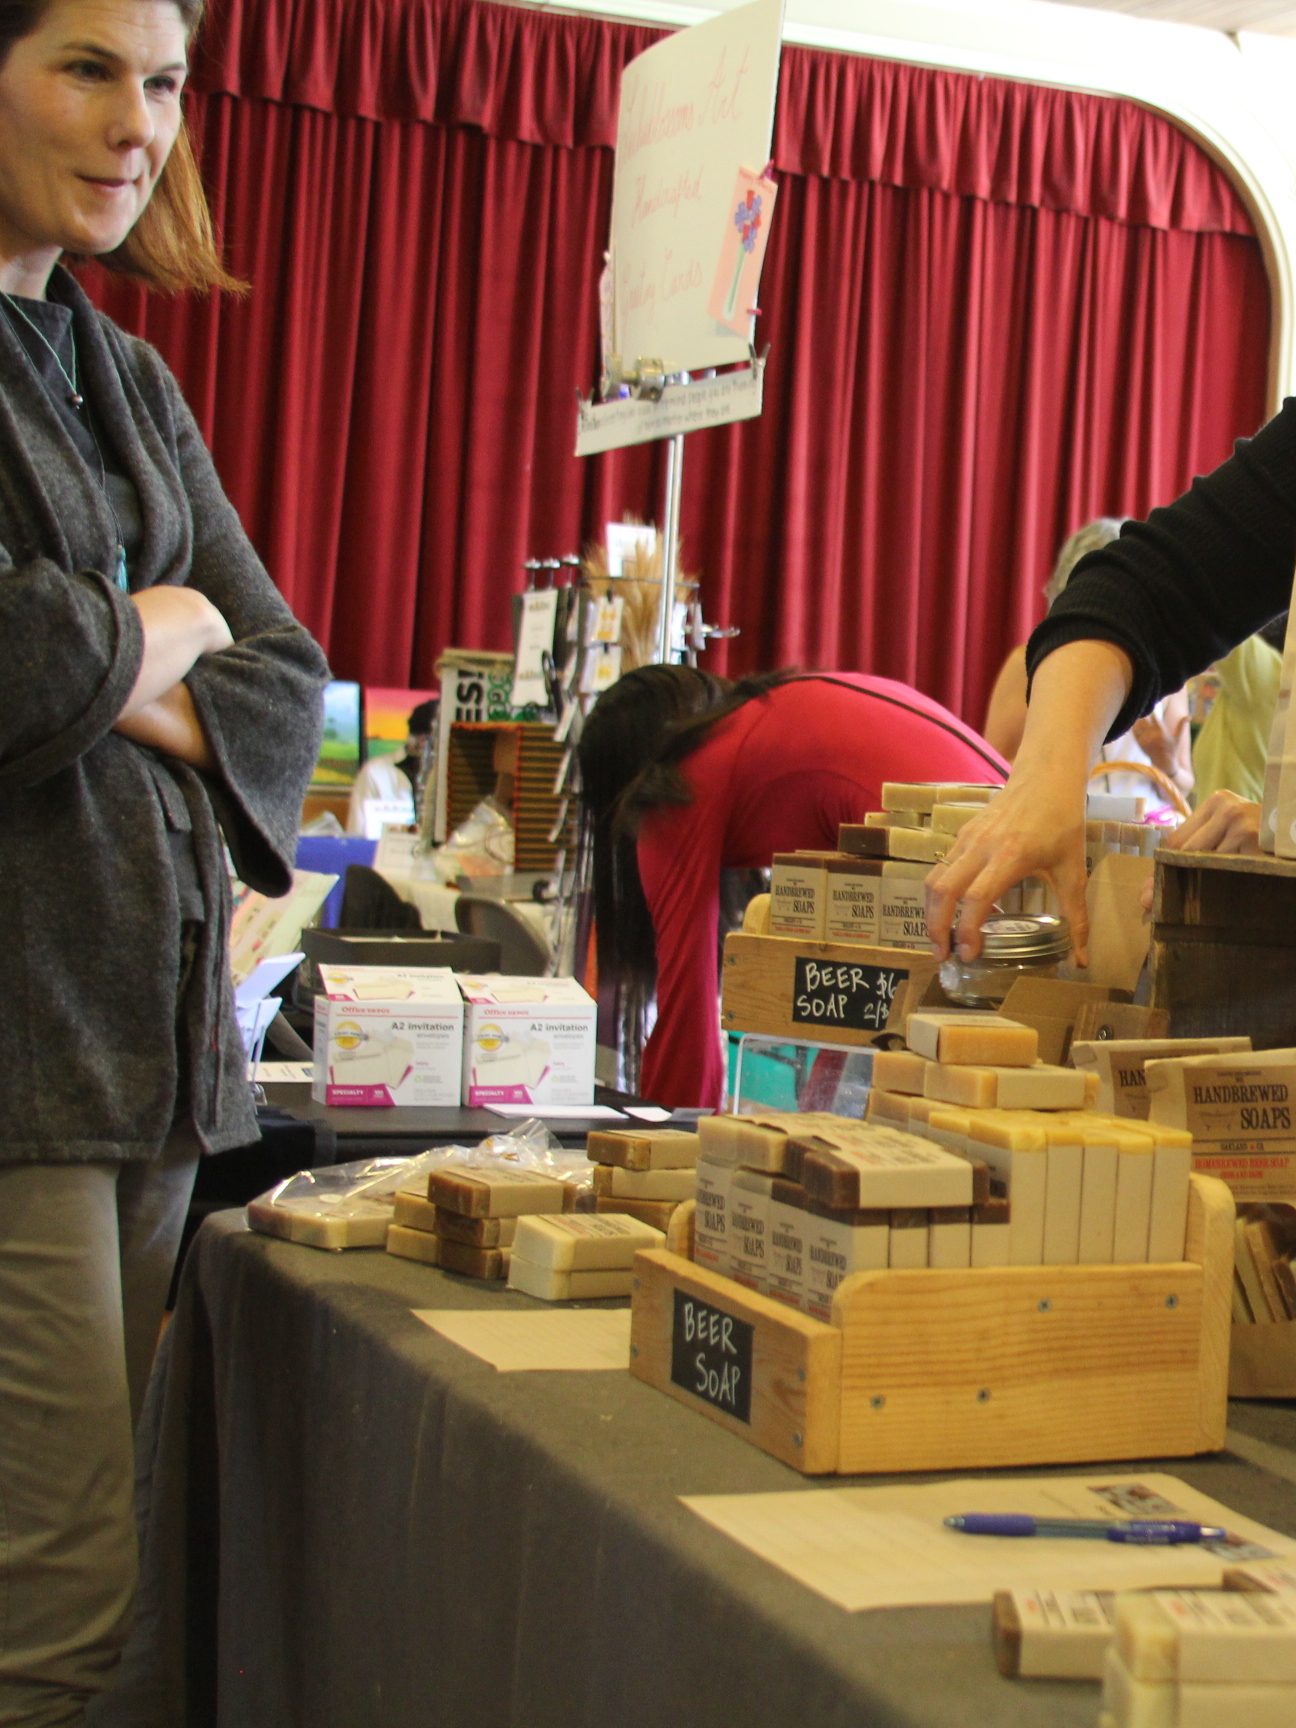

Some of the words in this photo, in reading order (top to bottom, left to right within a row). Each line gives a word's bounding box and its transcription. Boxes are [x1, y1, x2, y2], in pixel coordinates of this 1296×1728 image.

[775, 885, 815, 900] HANDBREWED
[833, 890, 874, 903] HANDBREWED
[793, 901, 815, 914] SOAPS
[852, 905, 874, 918] SOAPS
[805, 962, 870, 992] BEER
[797, 993, 848, 1019] SOAP
[391, 1022, 405, 1030] A2
[408, 1022, 454, 1031] invitation
[545, 1023, 588, 1031] invitation
[1193, 1084, 1289, 1104] HANDBREWED
[1240, 1107, 1291, 1130] SOAPS
[685, 1302, 737, 1355] BEER
[696, 1352, 741, 1406] SOAP
